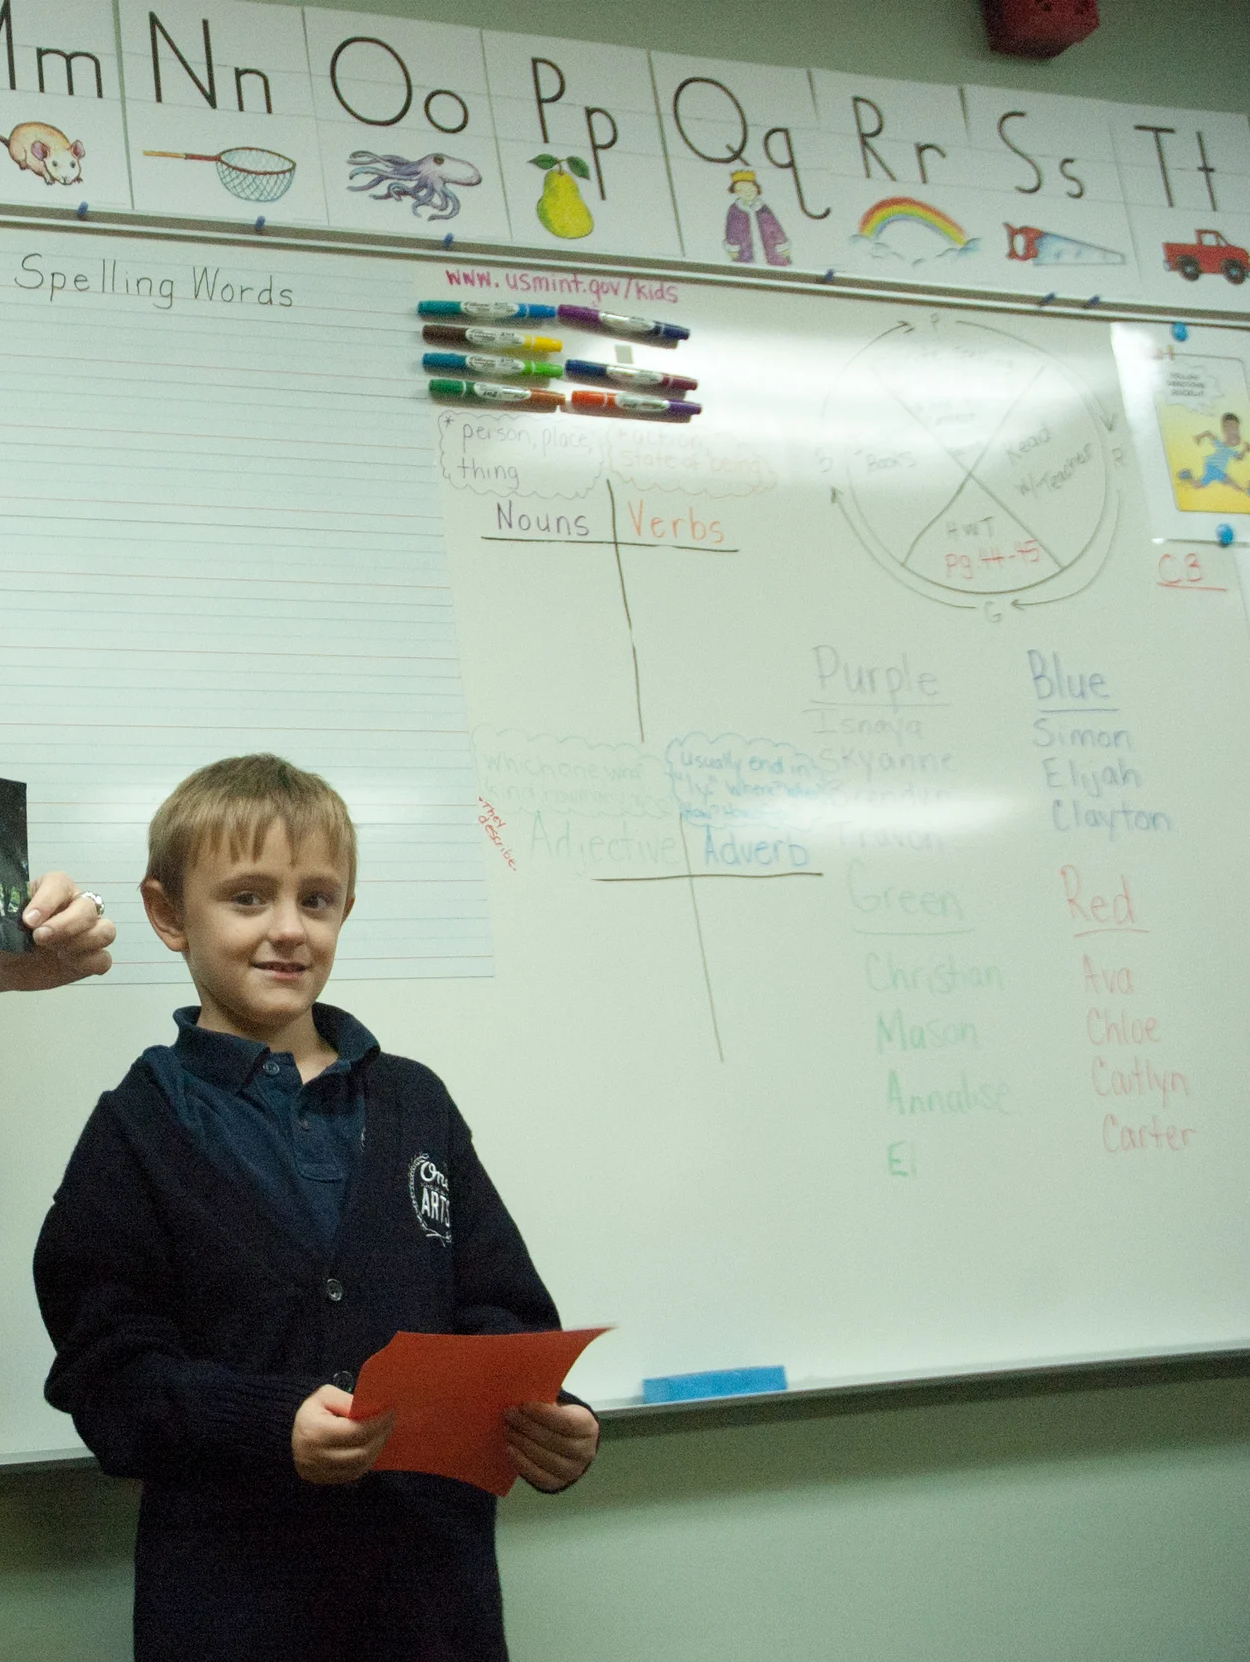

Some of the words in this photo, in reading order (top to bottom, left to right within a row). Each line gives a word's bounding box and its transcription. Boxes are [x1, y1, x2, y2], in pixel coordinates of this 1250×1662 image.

[148, 11, 273, 114] Nn
[330, 36, 469, 134] Oo
[531, 57, 619, 201] Pp
[672, 76, 831, 220] Qq
[852, 96, 947, 184] Rr
[997, 110, 1085, 198] Ss
[1134, 124, 1217, 212] Tt
[13, 251, 175, 309] Spelling
[193, 266, 295, 309] Words
[456, 455, 521, 491] thing
[495, 499, 591, 538] Nouns
[627, 499, 726, 545] Verbs
[812, 643, 940, 714] Purple
[1026, 648, 1111, 701] Blue
[1031, 717, 1134, 752] Simon
[705, 824, 810, 868] Adverb
[1059, 864, 1136, 926] Red
[1082, 953, 1135, 996] Ava
[1086, 1007, 1163, 1047] Chloe
[1102, 1112, 1198, 1154] Carter
